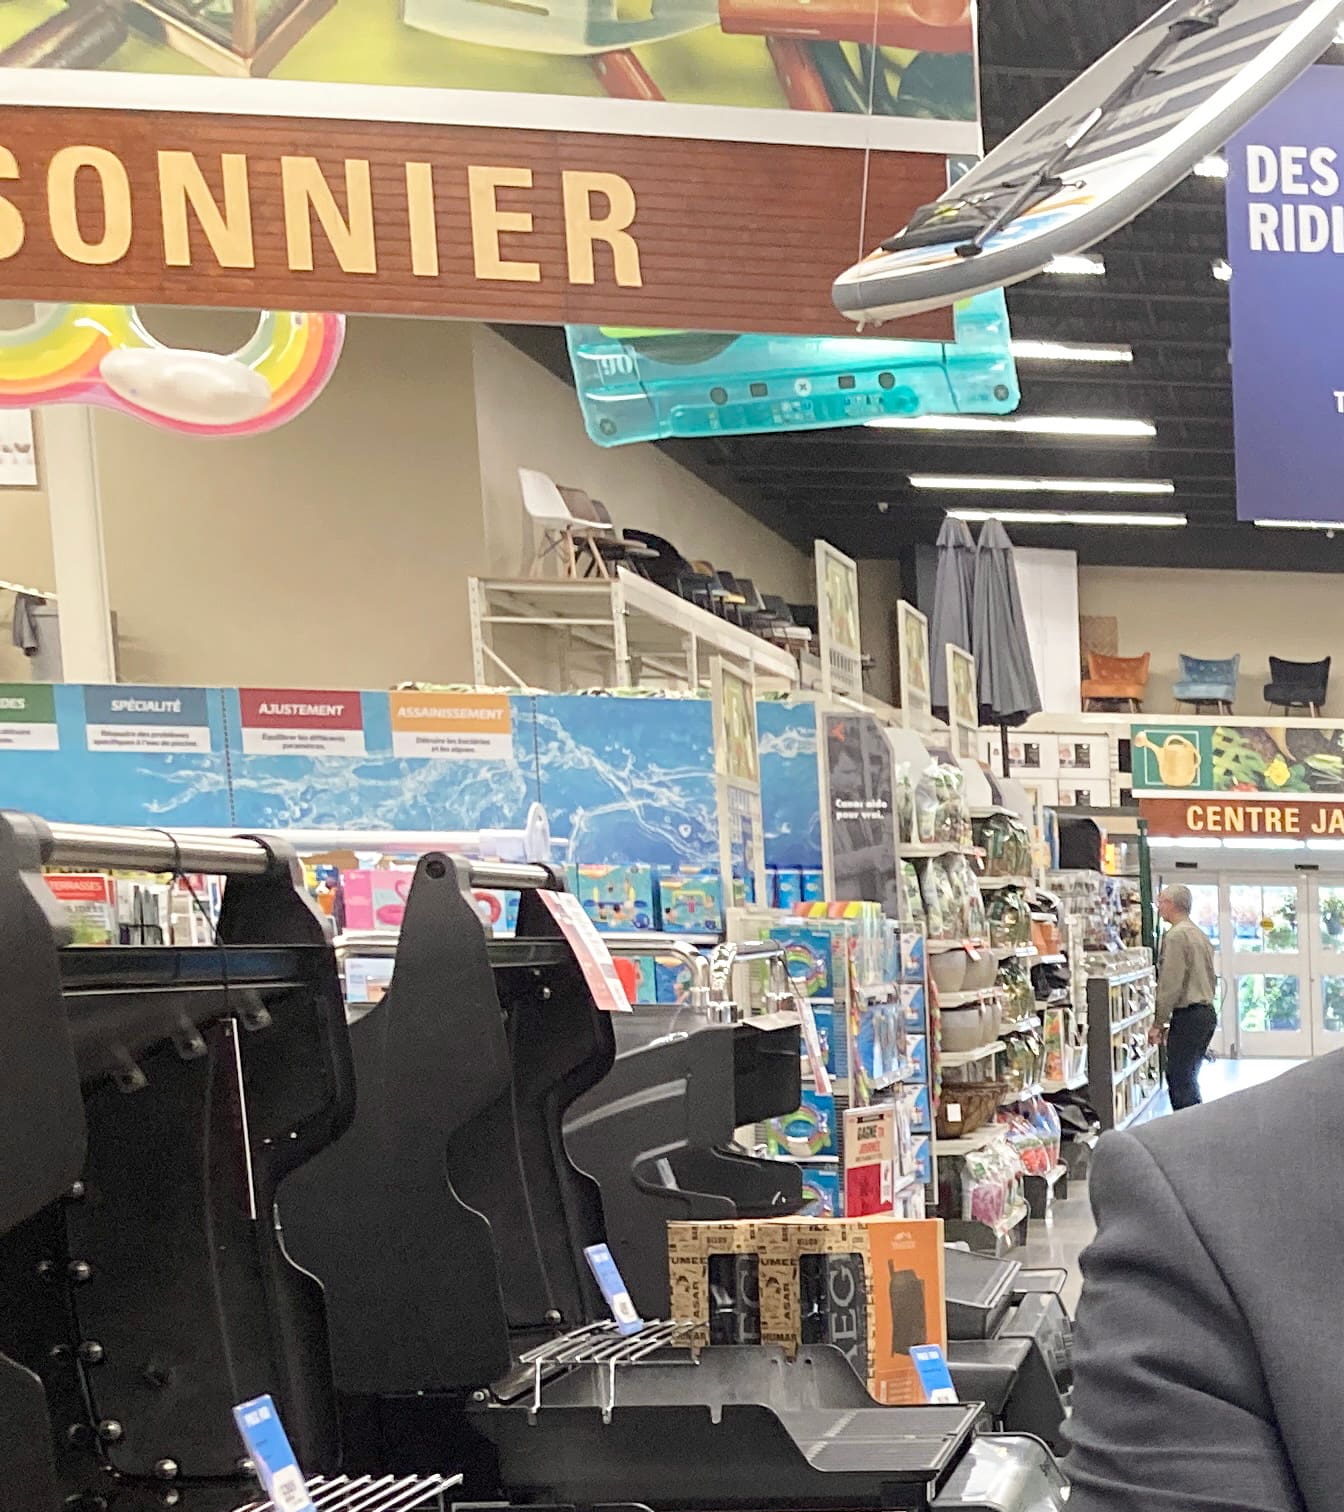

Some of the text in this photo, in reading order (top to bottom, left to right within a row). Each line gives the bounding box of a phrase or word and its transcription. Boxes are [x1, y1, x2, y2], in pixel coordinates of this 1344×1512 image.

[1246, 144, 1339, 198] DES
[111, 697, 181, 713] SPÉCIALITÉ
[258, 703, 345, 717] AJUSTEMENT
[397, 707, 504, 721] ASSAINISSEMENT
[836, 811, 859, 821] pour
[1186, 805, 1300, 833] CENTRE
